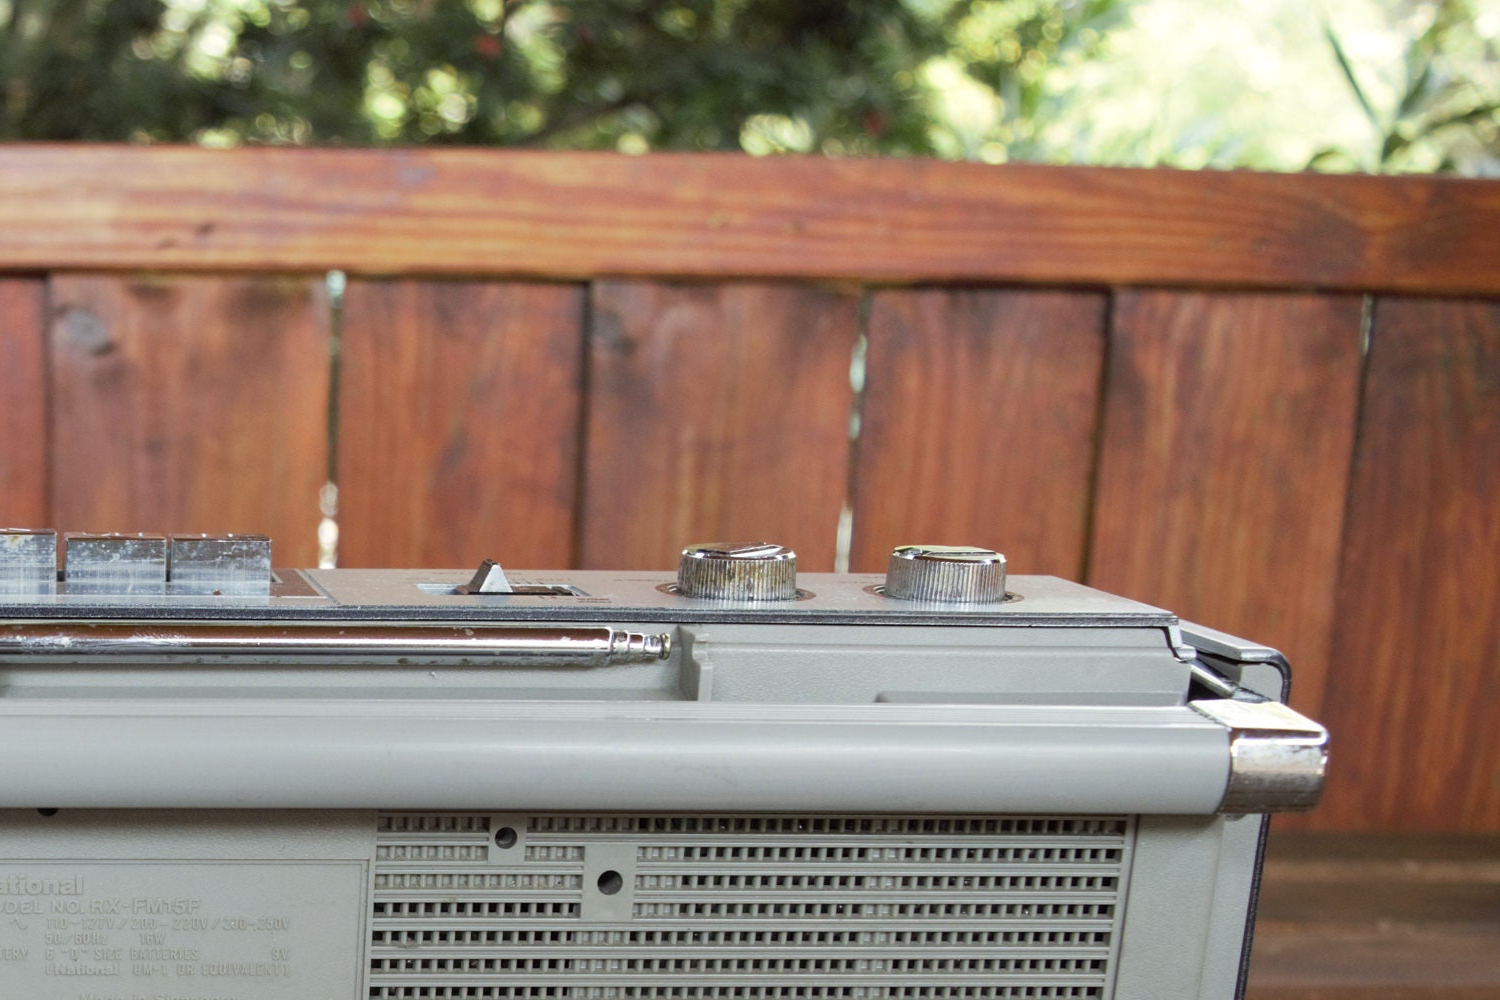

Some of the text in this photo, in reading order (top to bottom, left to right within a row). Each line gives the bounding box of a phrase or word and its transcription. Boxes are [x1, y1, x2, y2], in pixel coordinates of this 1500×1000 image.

[51, 899, 85, 915] NO.
[91, 899, 202, 915] RX-FM15F
[93, 948, 123, 961] SIZE
[130, 948, 199, 962] BATTERIES
[272, 948, 290, 962] 9V
